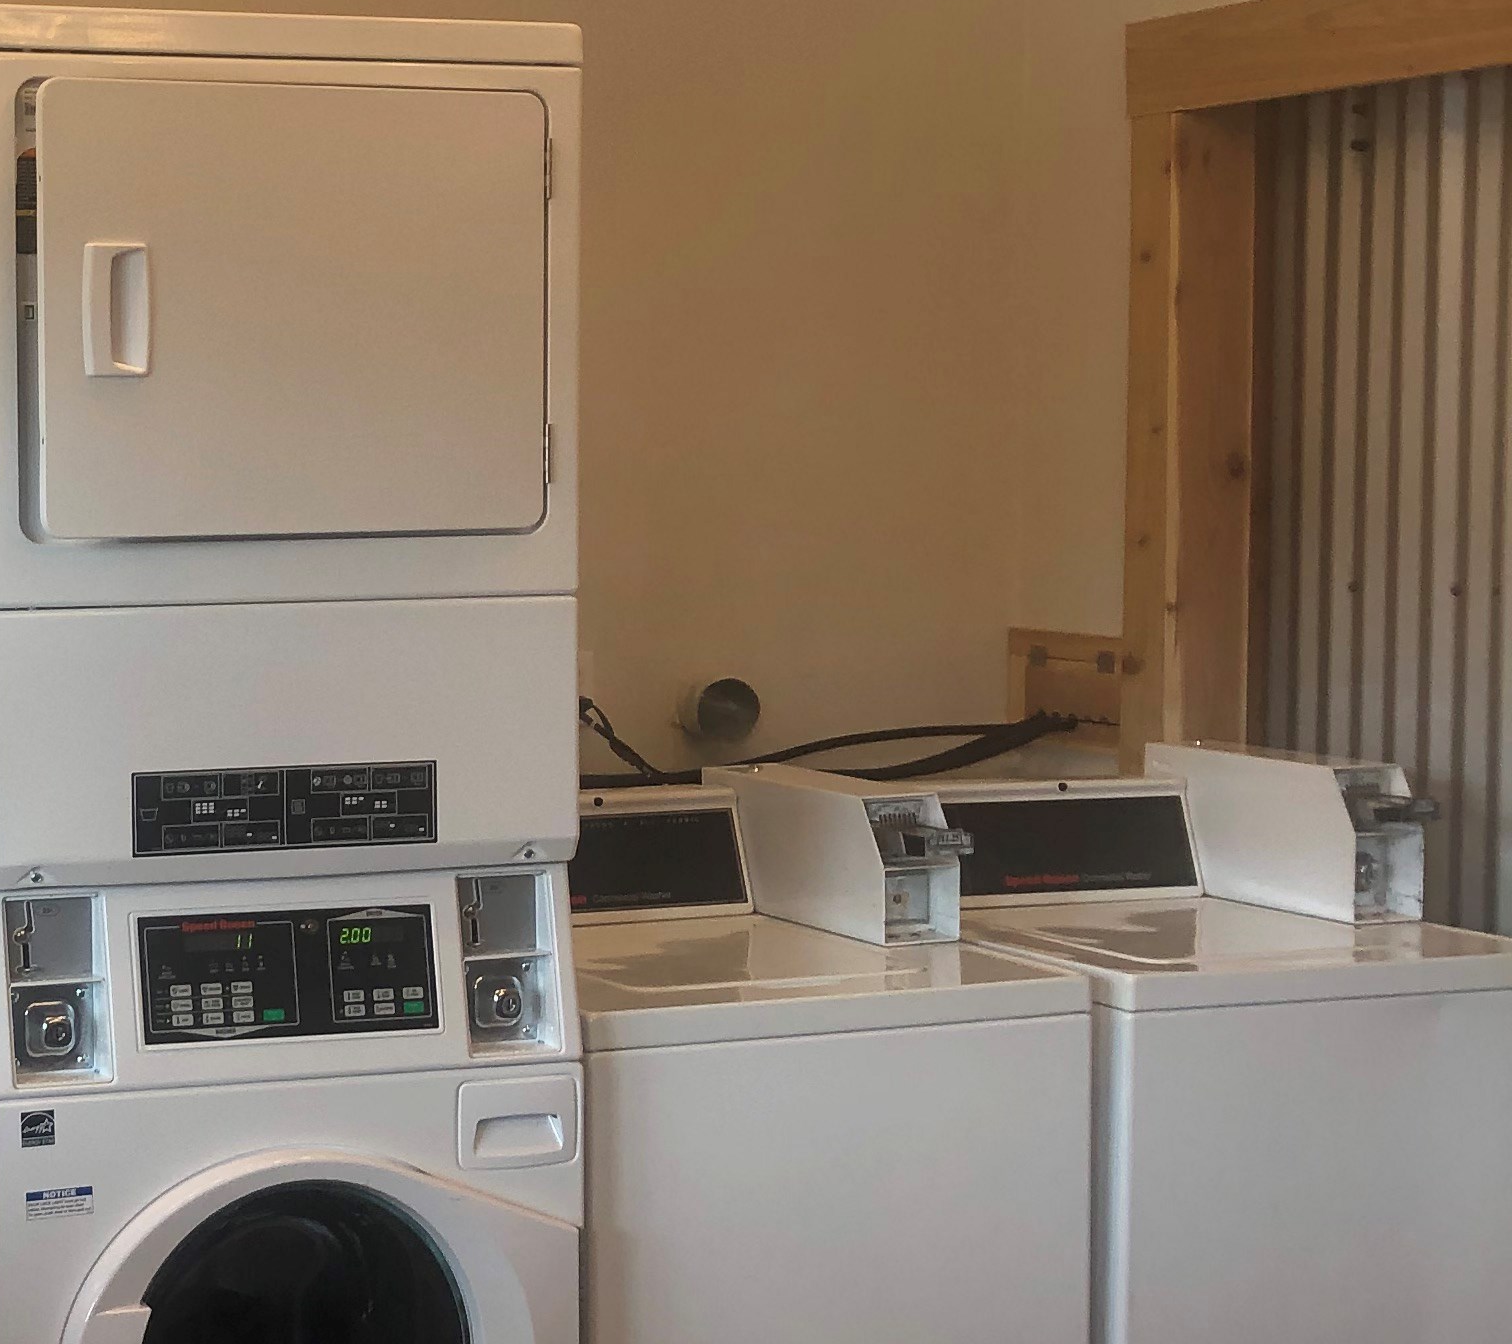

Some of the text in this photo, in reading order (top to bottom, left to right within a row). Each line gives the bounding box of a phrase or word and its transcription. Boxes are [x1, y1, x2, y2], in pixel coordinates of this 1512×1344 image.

[237, 933, 253, 949] 11
[340, 927, 372, 944] 2.00
[42, 1188, 77, 1200] NOTICE
